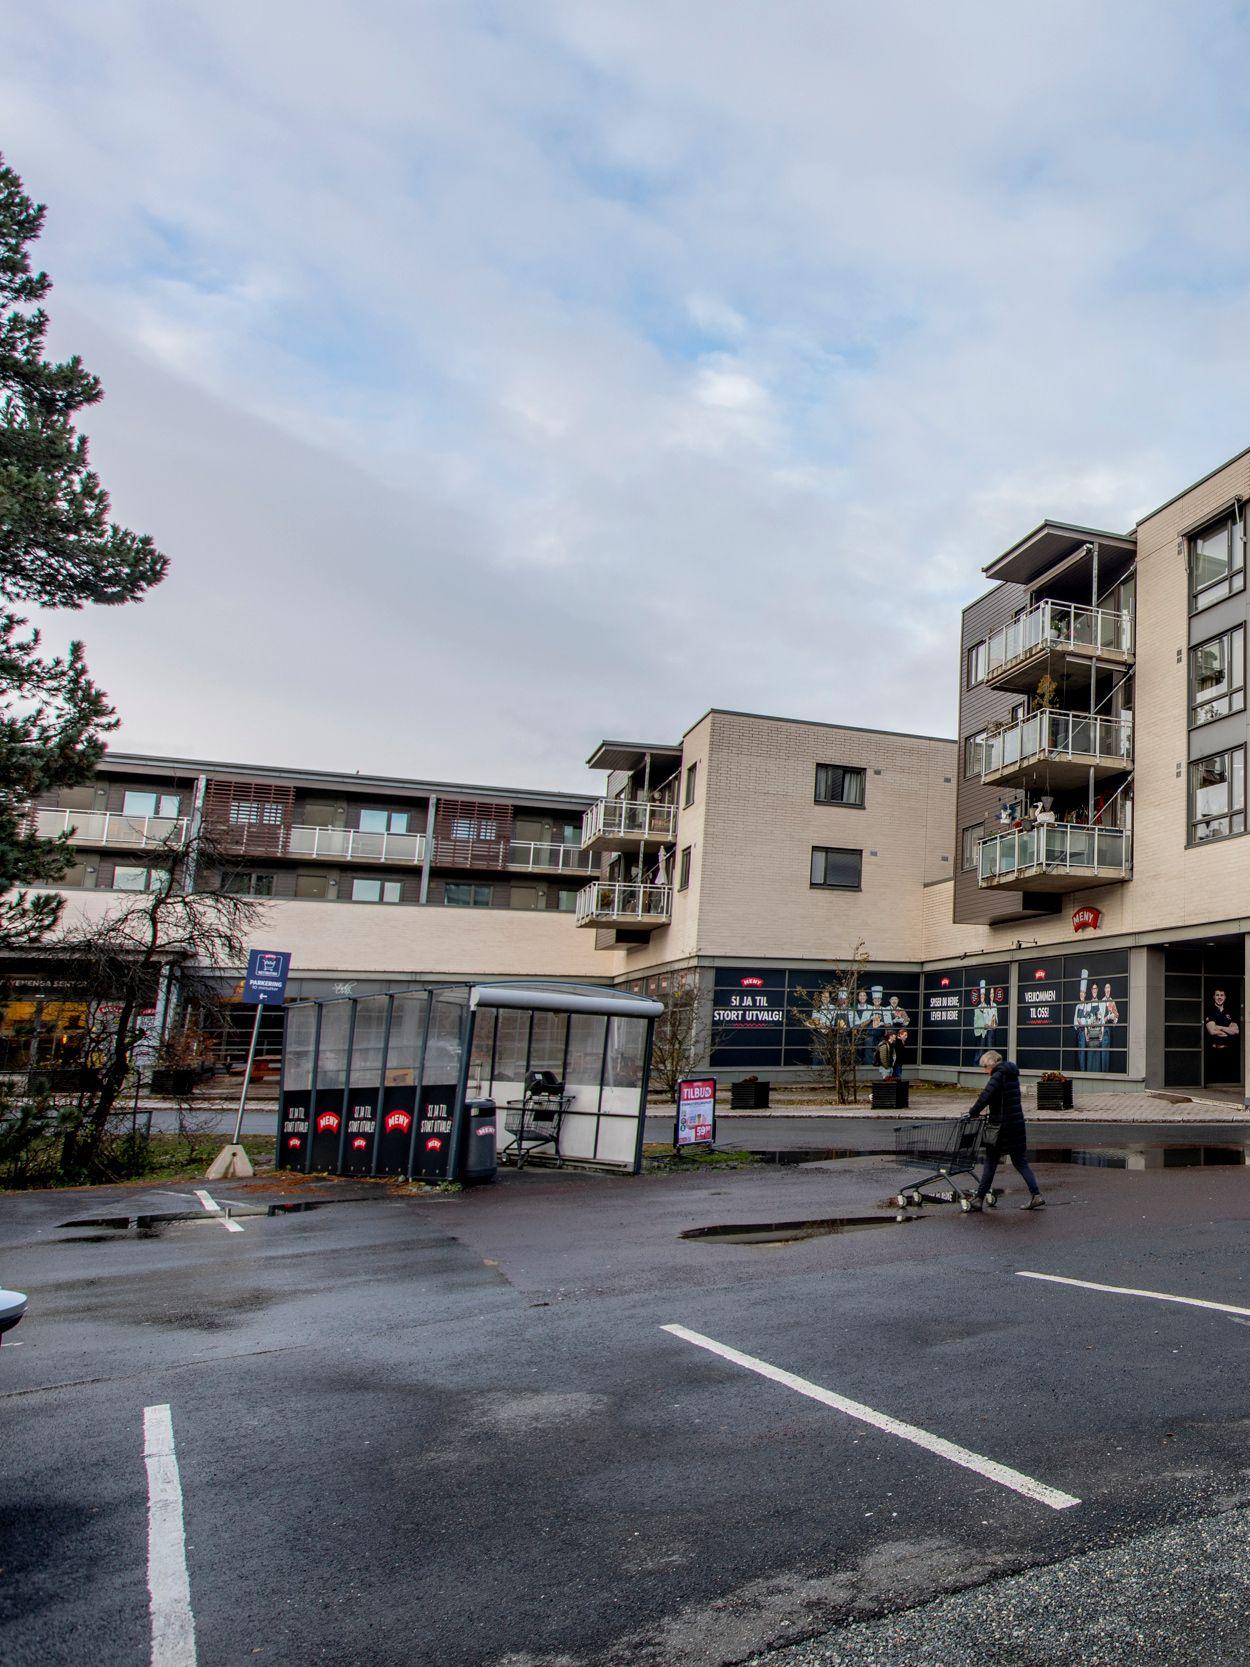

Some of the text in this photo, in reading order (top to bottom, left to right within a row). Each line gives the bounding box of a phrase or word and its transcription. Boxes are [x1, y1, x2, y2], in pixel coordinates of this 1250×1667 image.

[1073, 911, 1094, 926] MENY
[249, 979, 283, 988] PARKERING
[731, 996, 768, 1006] SI JA TIL
[1025, 990, 1056, 1002] VELKOMMEN
[714, 1010, 782, 1021] STORT UTVALG!
[683, 1087, 711, 1099] TILBUD
[320, 1116, 339, 1128] MENY
[388, 1114, 409, 1127] MENY
[421, 1120, 434, 1133] STORT
